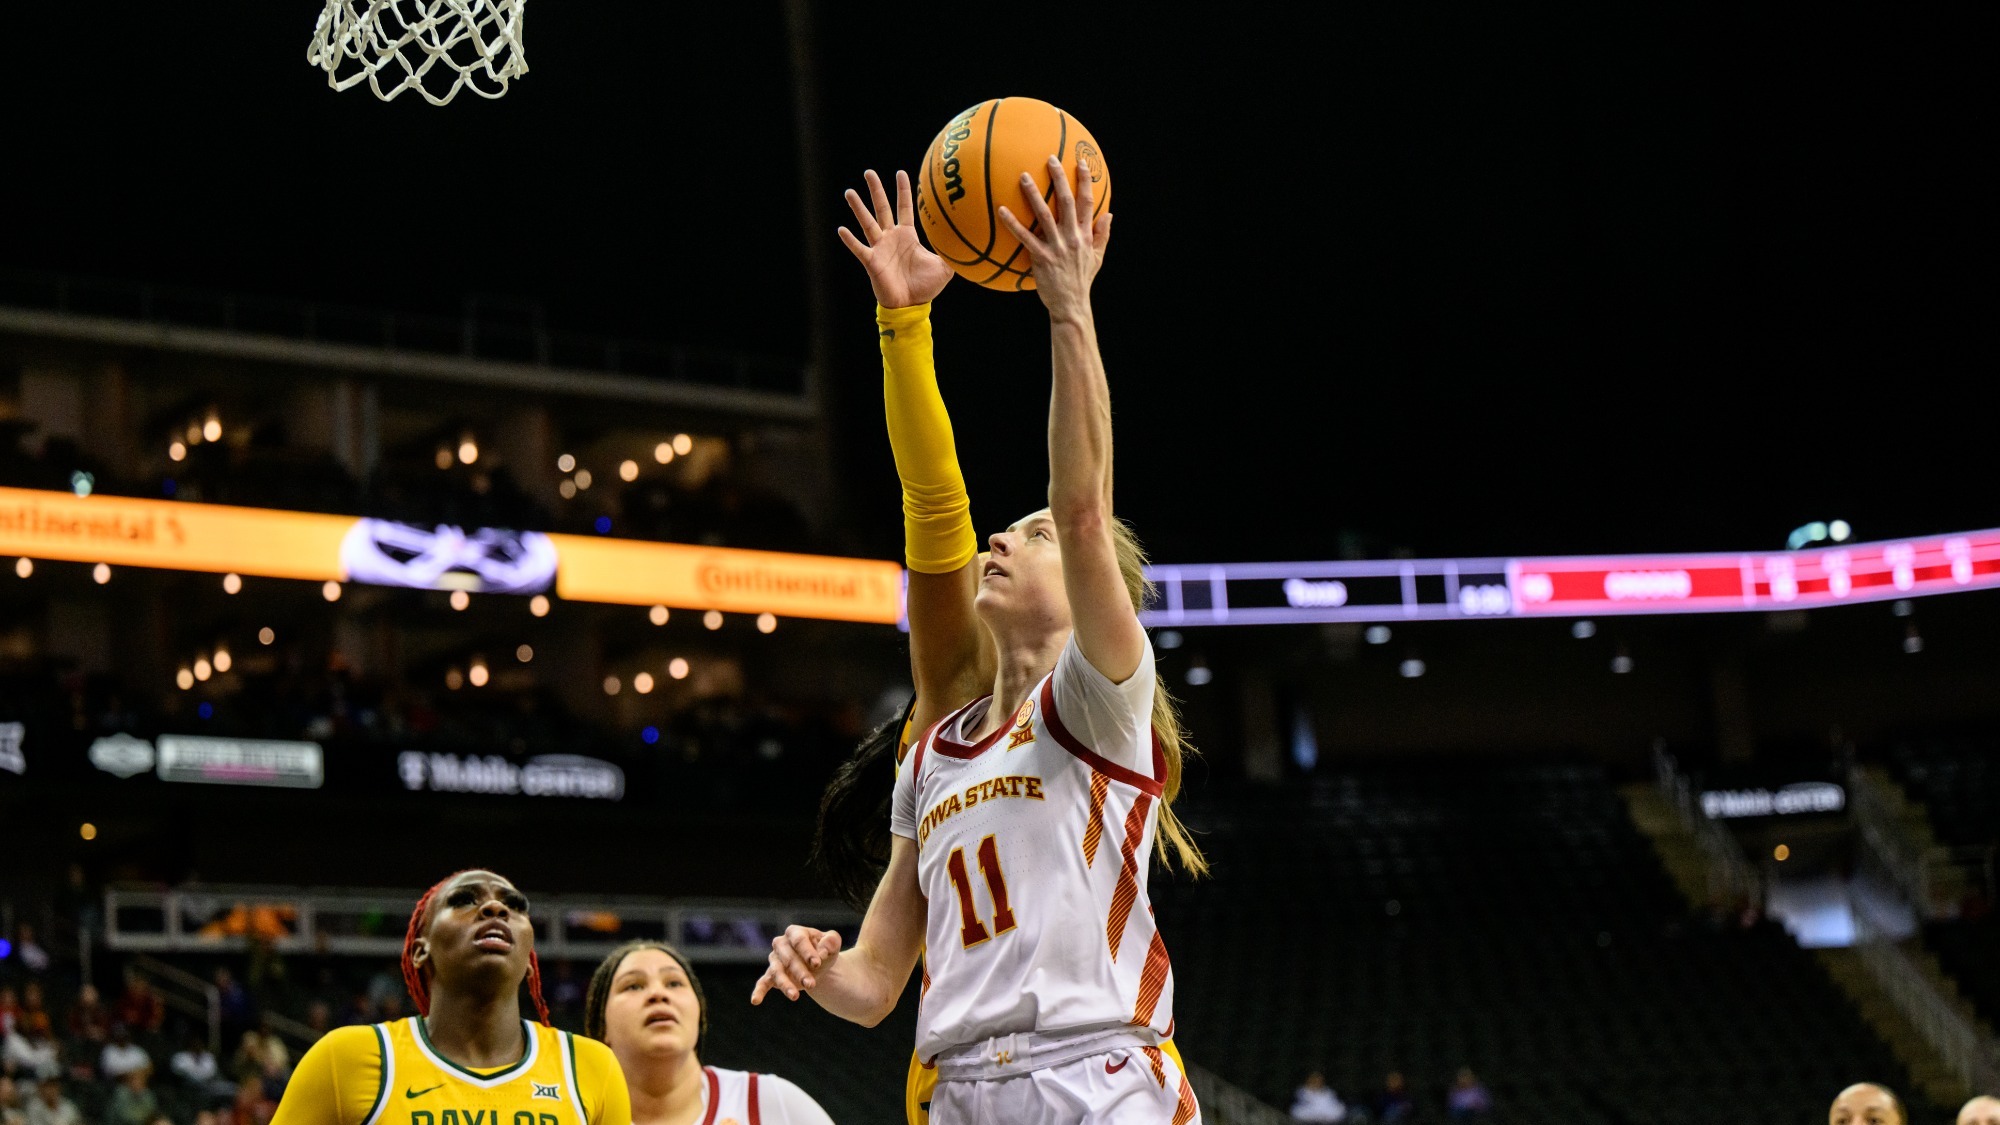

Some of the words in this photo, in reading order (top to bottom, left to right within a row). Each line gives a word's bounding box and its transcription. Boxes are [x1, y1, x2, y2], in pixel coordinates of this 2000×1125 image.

[918, 792, 962, 850] IOWA
[963, 775, 1045, 808] STATE
[946, 833, 1018, 950] 11
